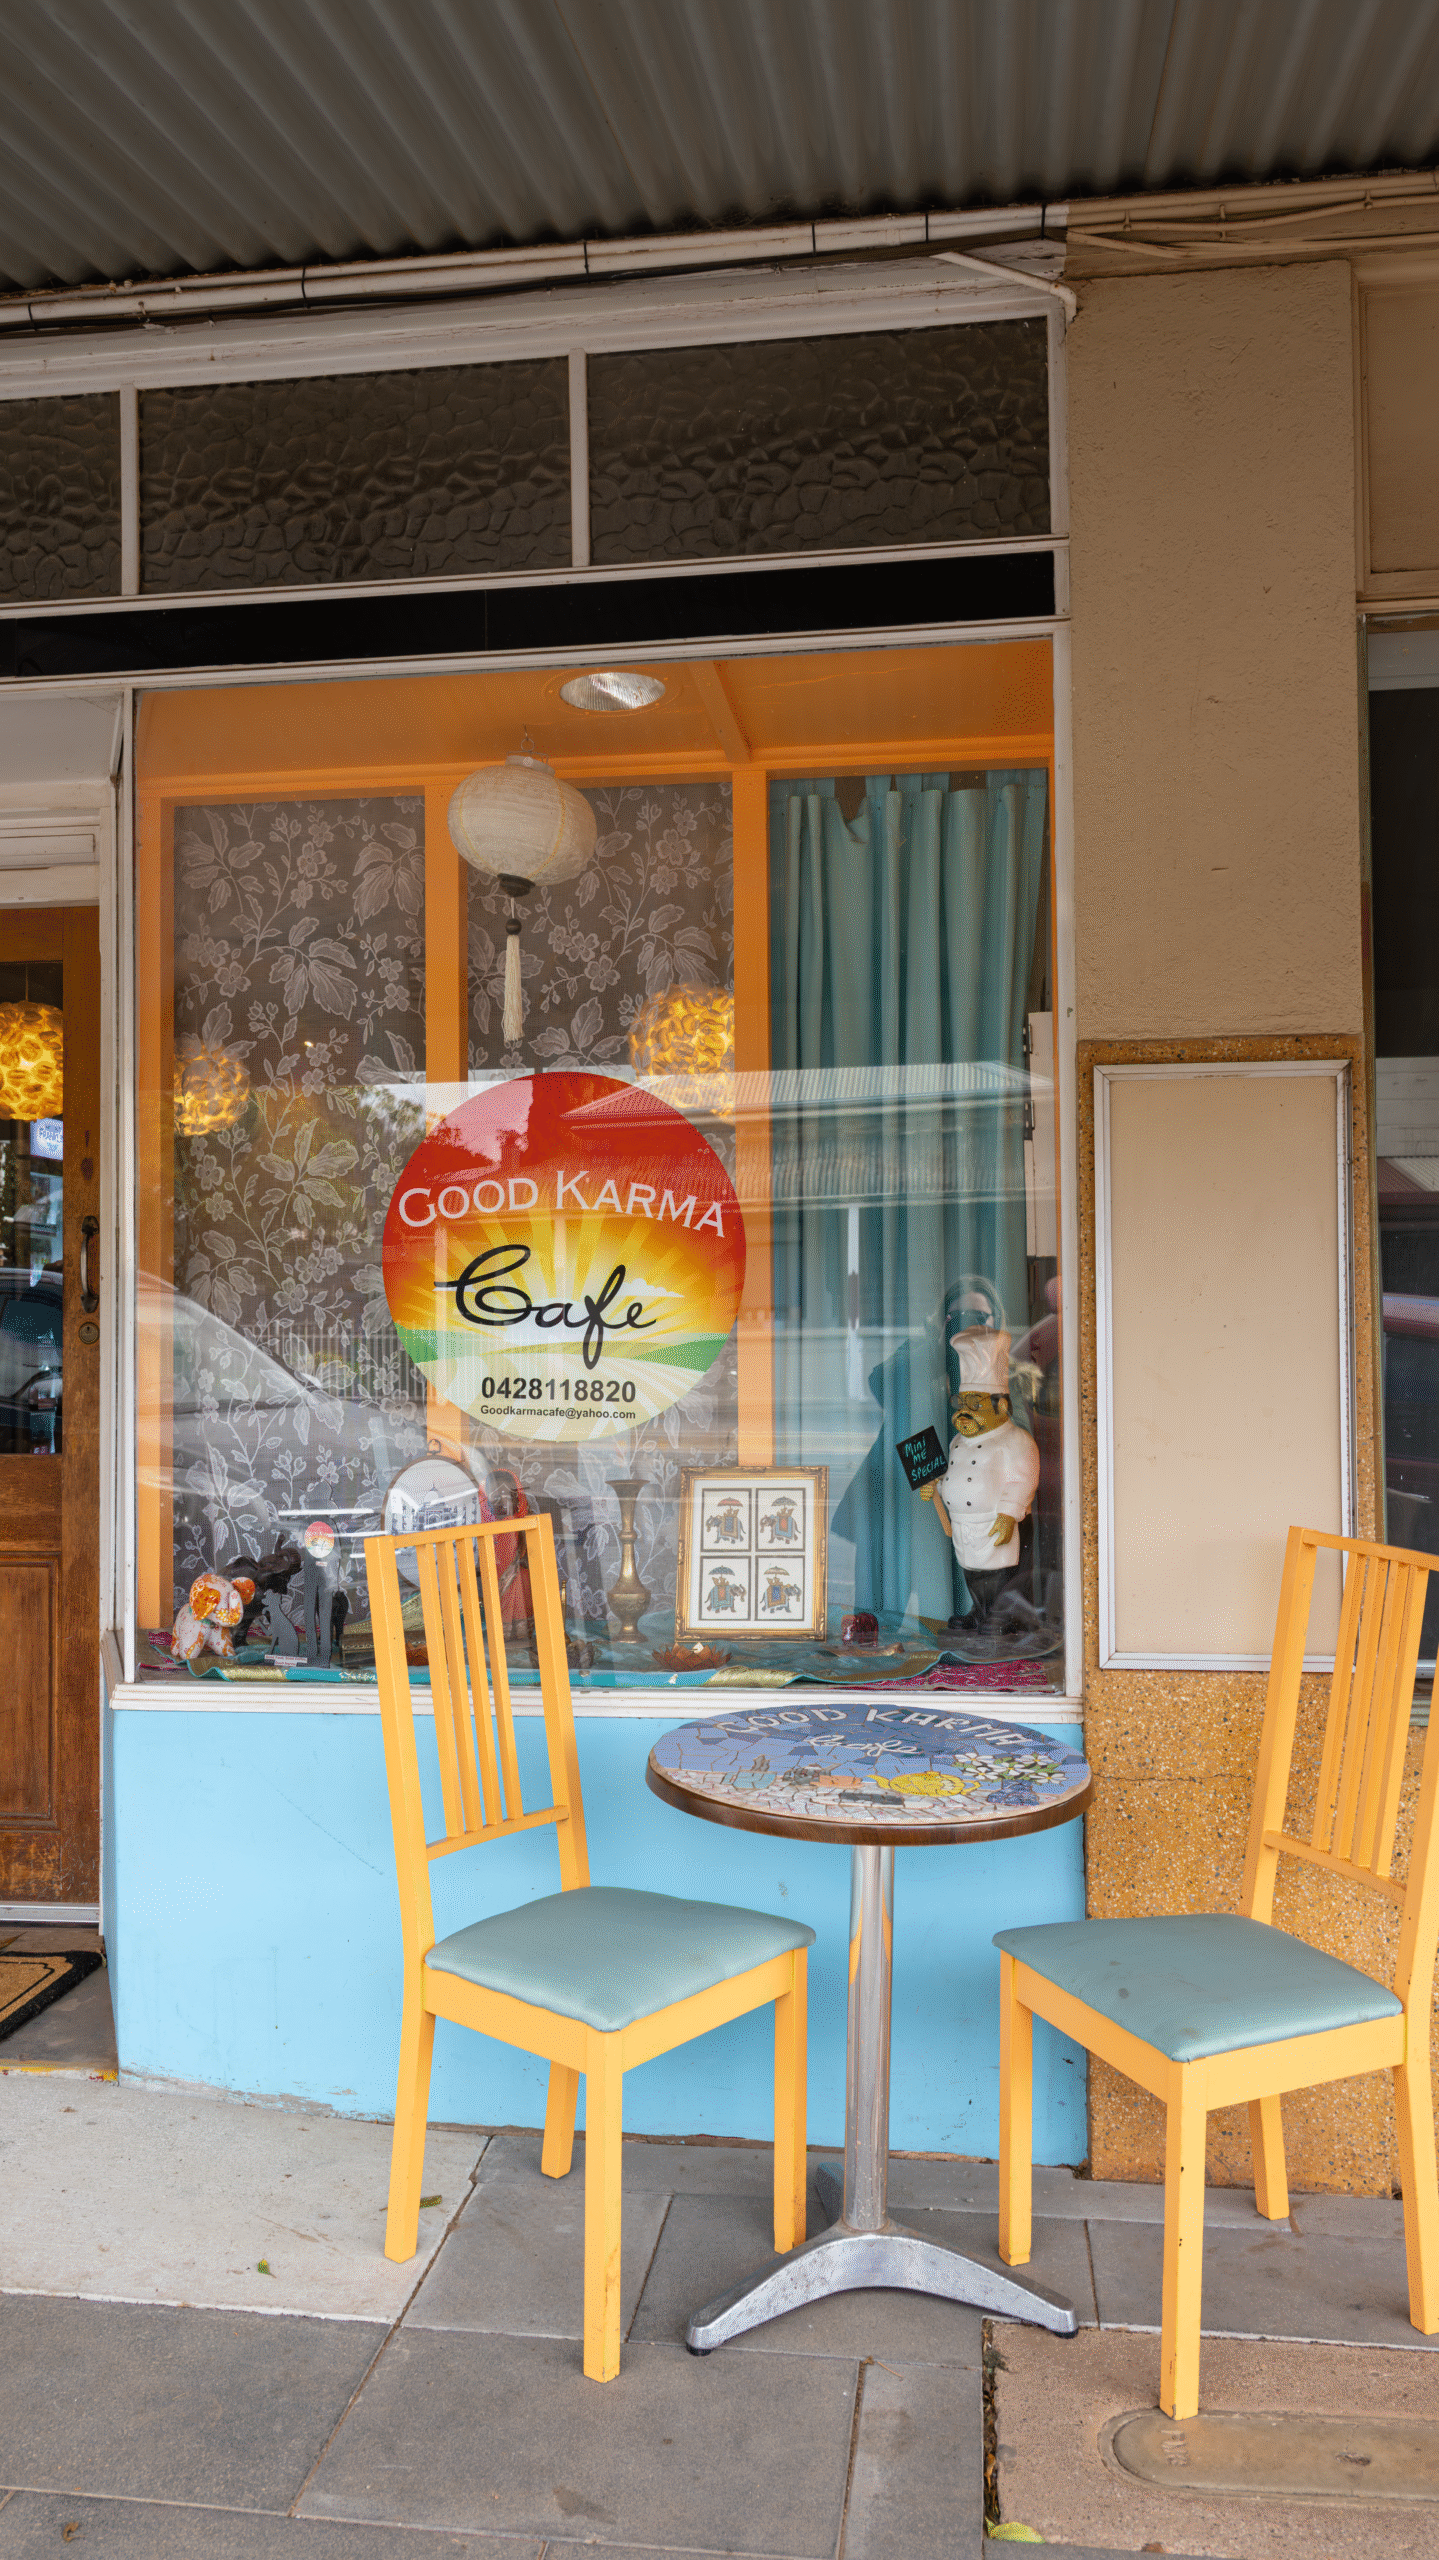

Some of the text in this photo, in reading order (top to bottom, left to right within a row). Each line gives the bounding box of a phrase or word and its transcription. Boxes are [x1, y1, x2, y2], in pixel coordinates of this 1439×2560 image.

[398, 1170, 726, 1238] GOOD KARMA
[433, 1243, 657, 1370] Cafe
[481, 1376, 637, 1404] 0428118820
[480, 1404, 637, 1421] Goodkarmacafe@yahoo.com
[911, 1455, 946, 1482] SPECIAL
[716, 1708, 1035, 1746] GOOD KARMA
